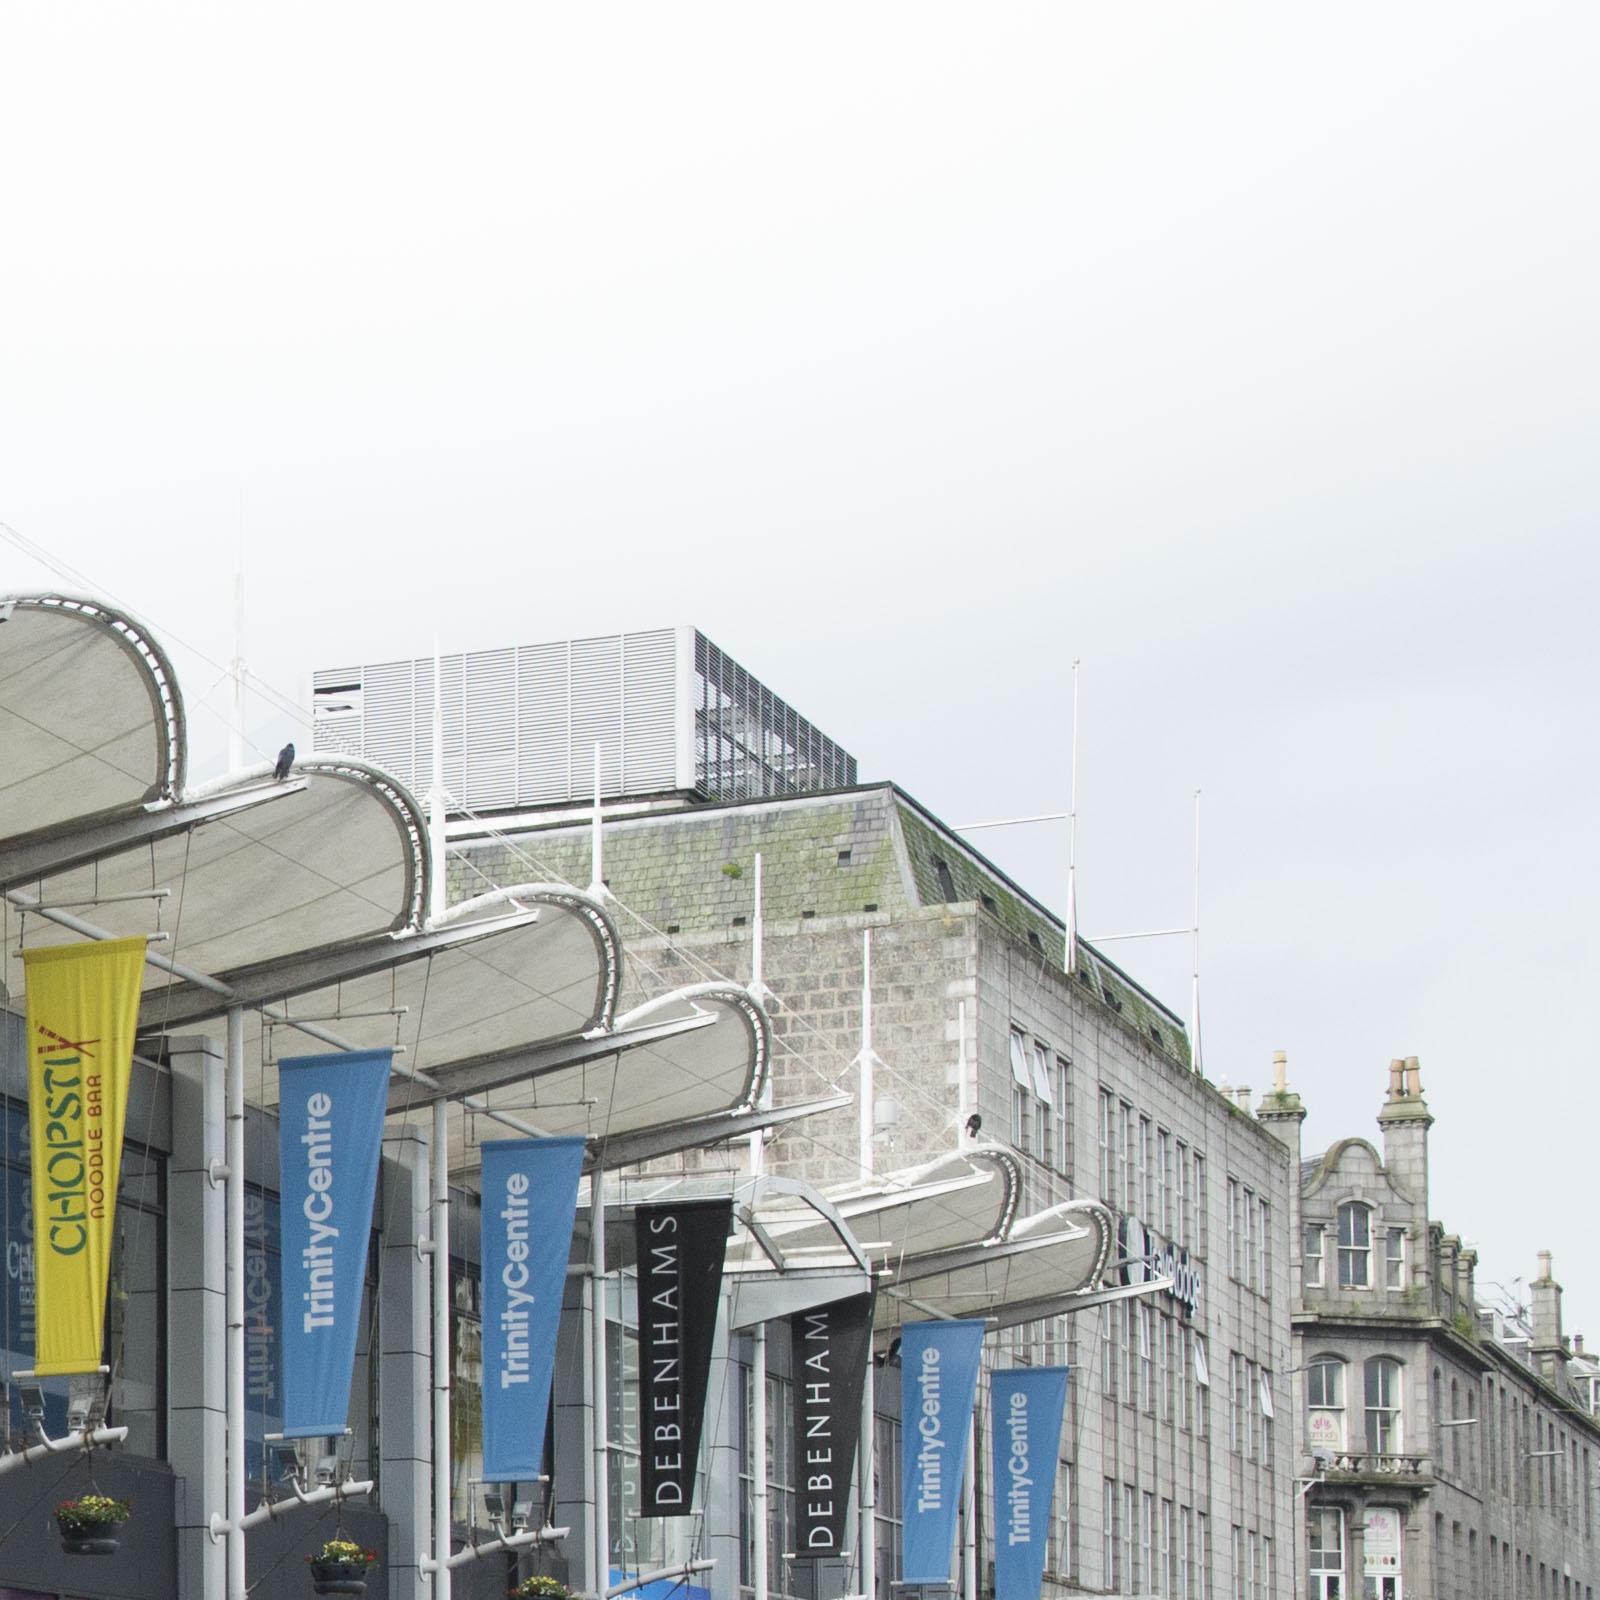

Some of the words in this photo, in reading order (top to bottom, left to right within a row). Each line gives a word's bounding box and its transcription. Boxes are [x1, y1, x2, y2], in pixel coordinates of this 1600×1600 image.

[86, 1074, 102, 1117] BAR
[301, 1092, 339, 1333] TrinityCentre
[501, 1173, 535, 1389] TrinityCentre
[650, 1215, 683, 1505] DEBENHAMS
[918, 1347, 945, 1513] TrinityCentre
[1006, 1391, 1033, 1546] TrinityCentre
